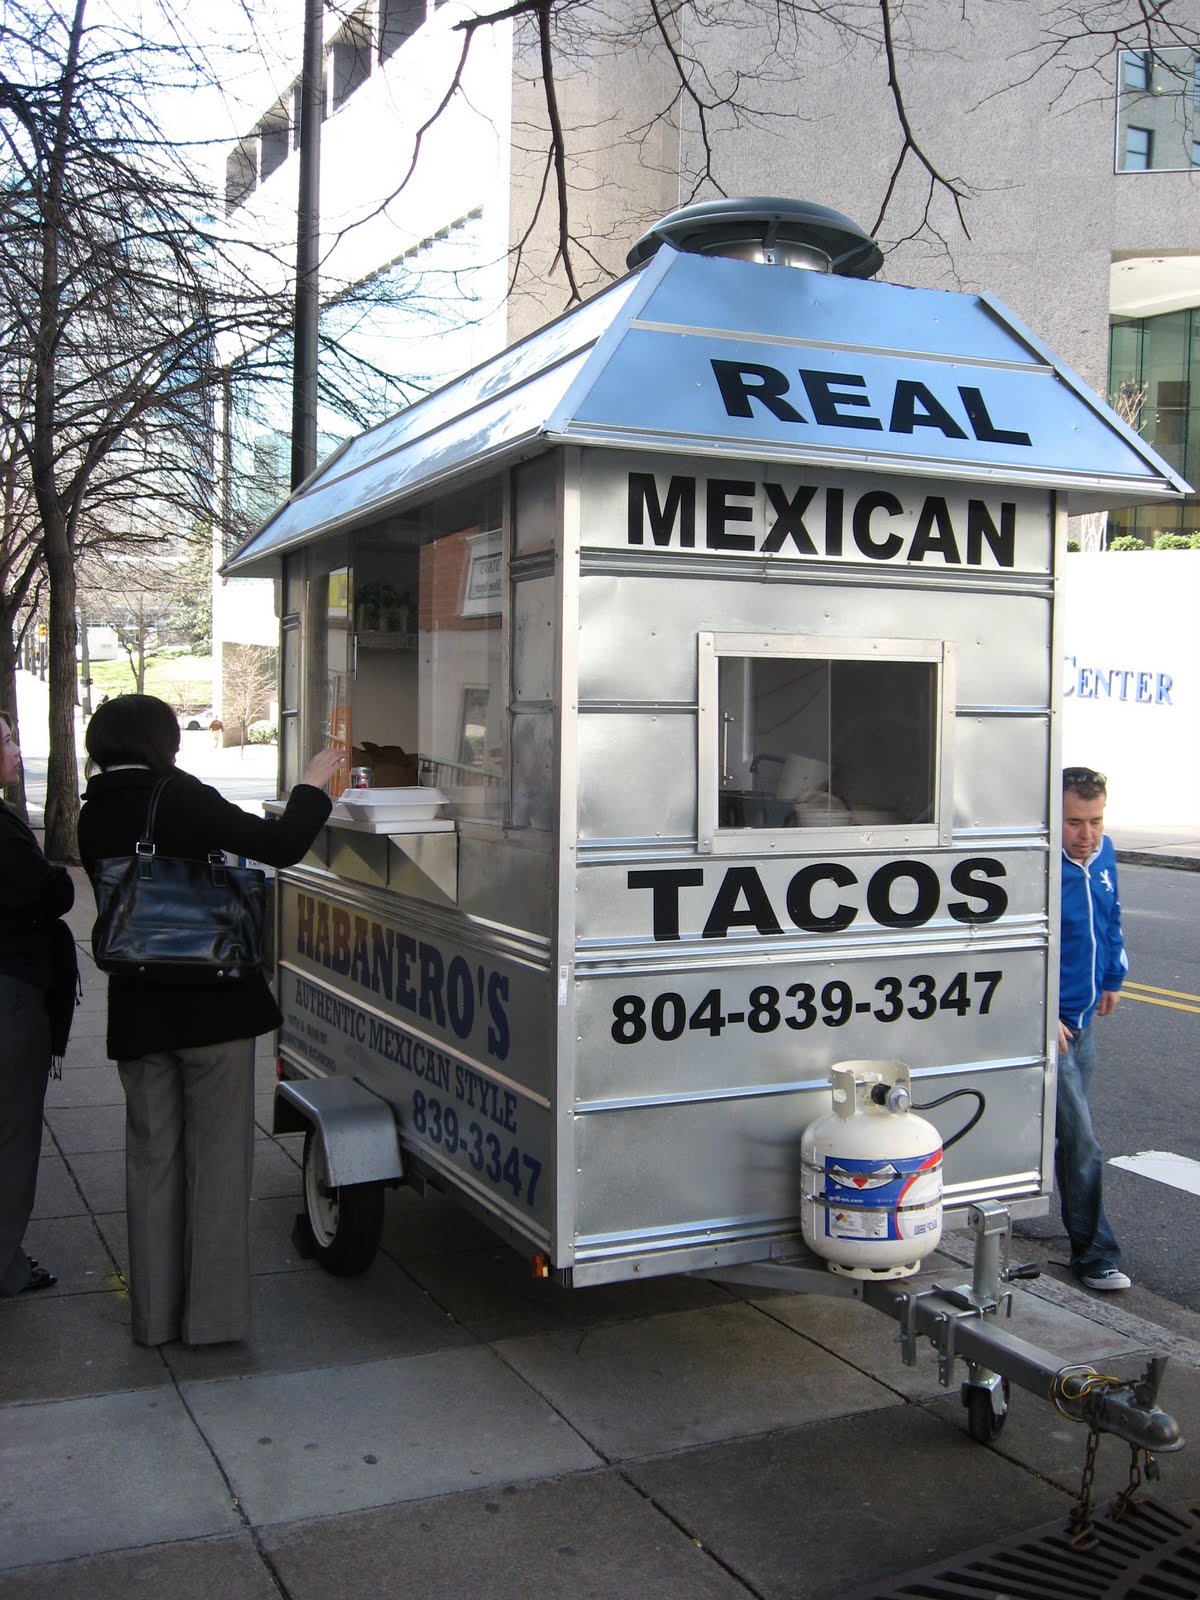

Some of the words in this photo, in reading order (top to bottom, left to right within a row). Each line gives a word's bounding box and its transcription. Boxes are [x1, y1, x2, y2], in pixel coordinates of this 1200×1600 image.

[710, 358, 1033, 447] REAL
[627, 472, 1016, 568] MEXICAN
[627, 857, 1009, 942] TACOS
[297, 893, 511, 1061] HABANERO'S
[610, 970, 1003, 1045] 804-839-3347
[295, 978, 366, 1043] AUTHENTIC
[368, 1018, 450, 1094] MEXICAN
[455, 1064, 518, 1135] STYLE
[412, 1089, 543, 1207] 839-3347
